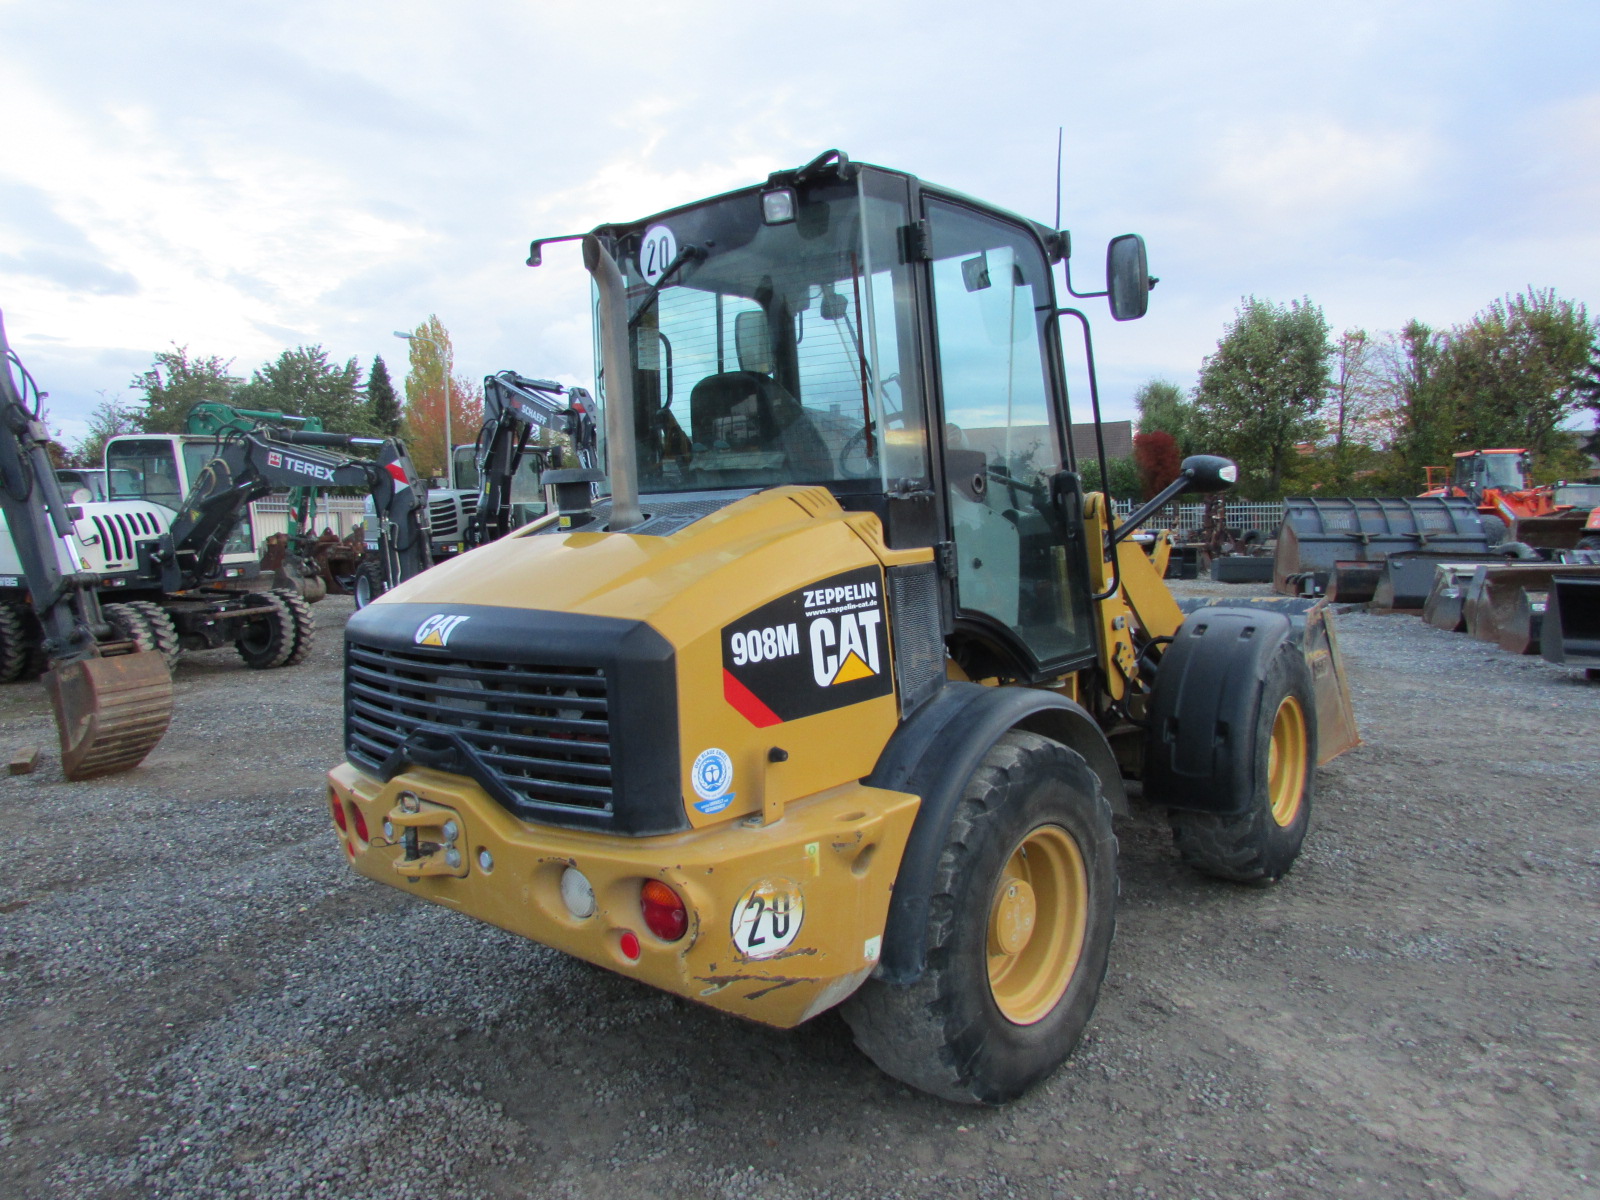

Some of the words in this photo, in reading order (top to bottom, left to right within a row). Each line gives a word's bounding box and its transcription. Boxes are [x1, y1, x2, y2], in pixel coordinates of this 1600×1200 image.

[648, 237, 669, 275] 20
[521, 404, 547, 425] SCHAEFF
[285, 457, 335, 482] TEREX
[803, 582, 876, 608] ZEPPELIN
[805, 599, 877, 617] www.zeppelin-cat.de
[415, 614, 470, 646] CAT
[731, 623, 799, 665] 908M
[810, 609, 880, 687] CAT
[749, 893, 789, 947] 20
